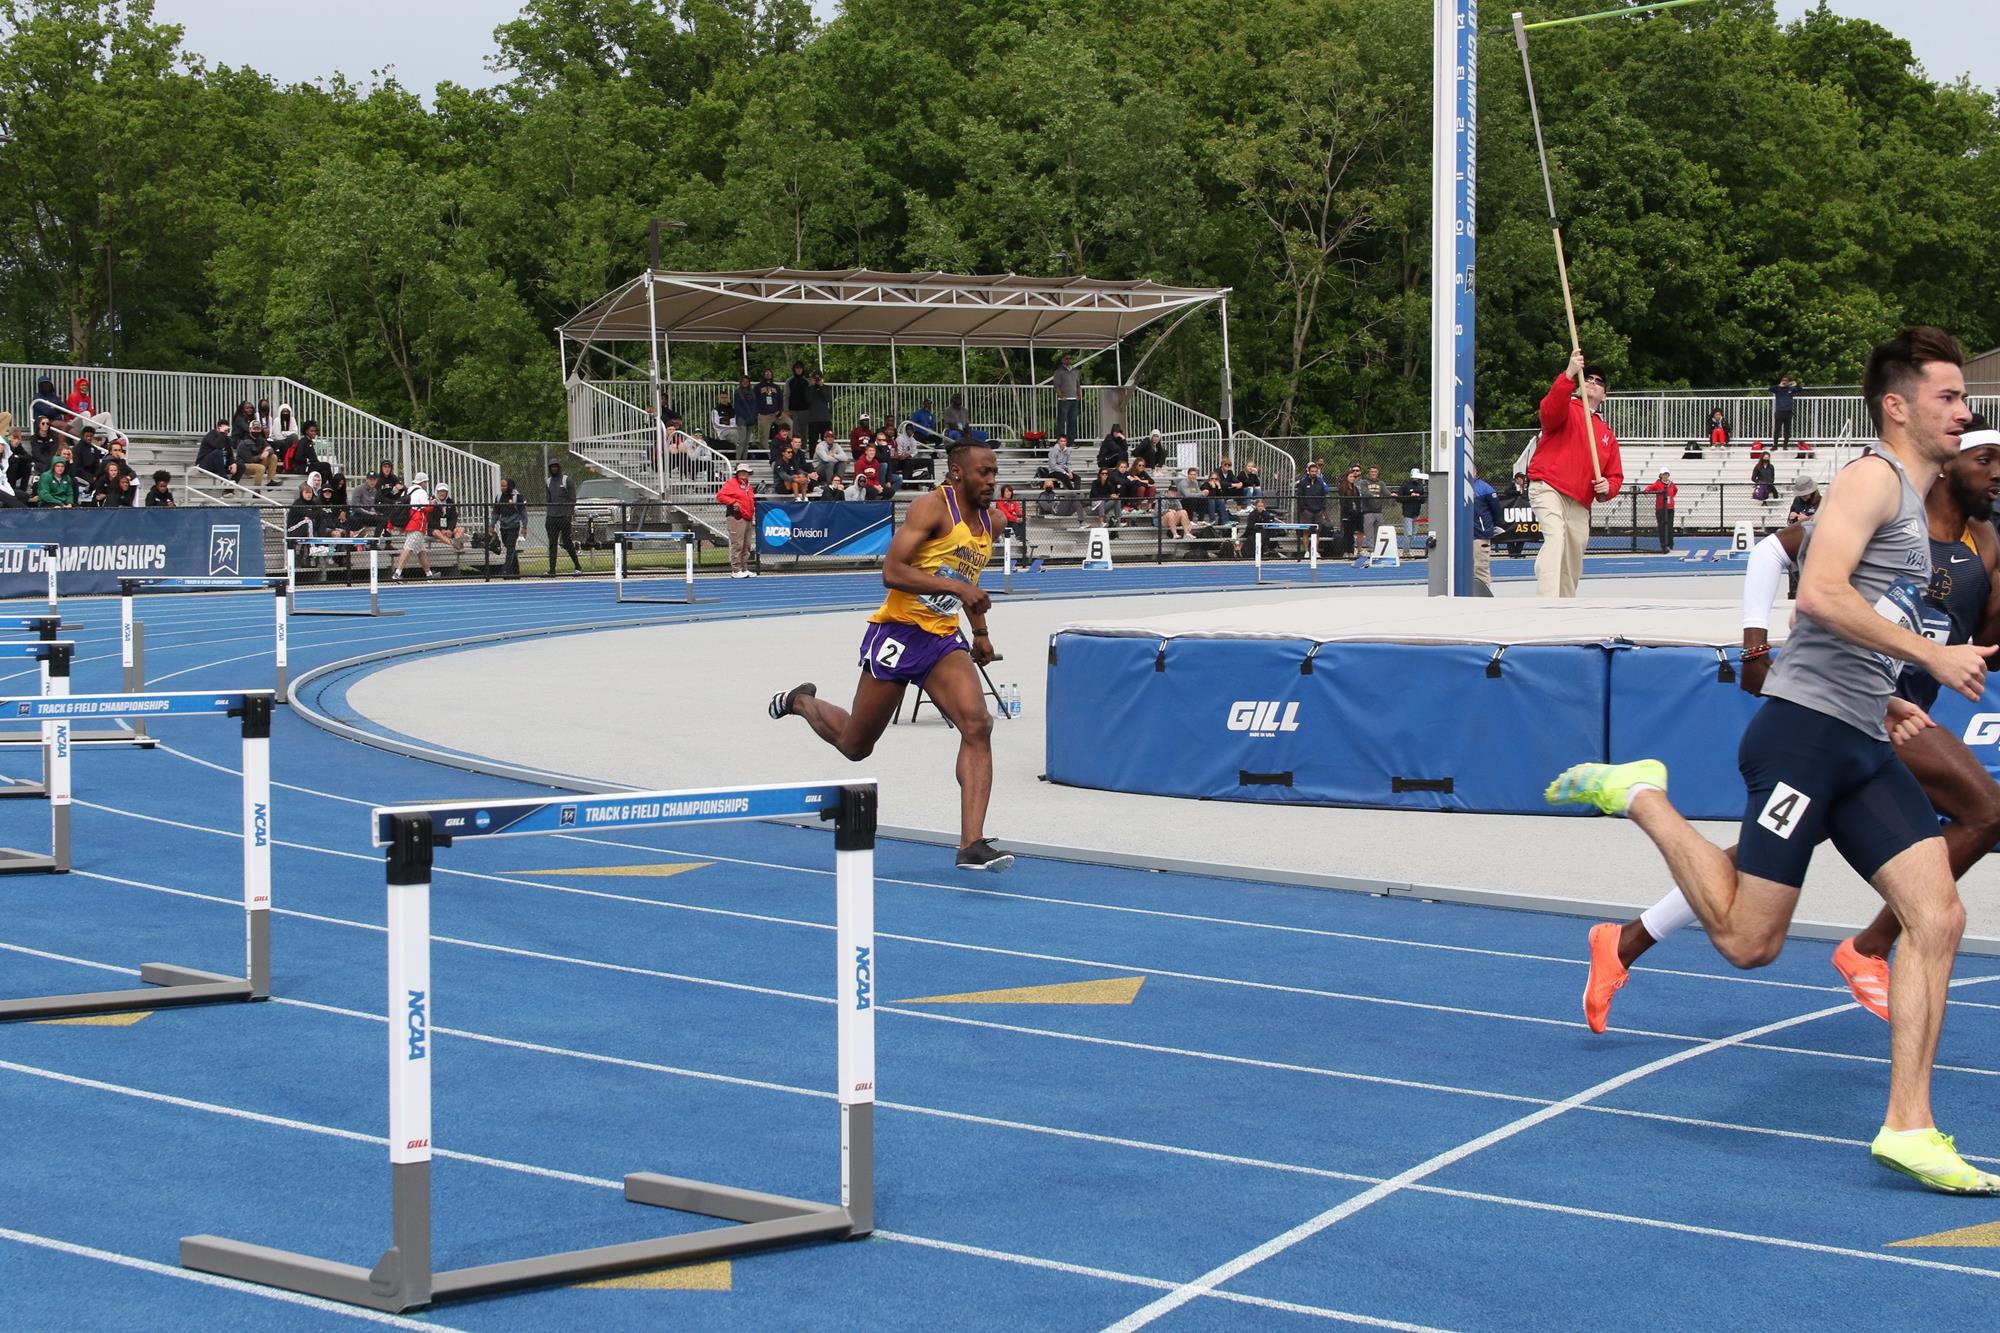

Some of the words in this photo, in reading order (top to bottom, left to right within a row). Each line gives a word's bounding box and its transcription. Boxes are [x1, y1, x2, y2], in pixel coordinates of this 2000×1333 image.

[1457, 13, 1465, 29] 14
[1457, 65, 1464, 80] 13
[1457, 117, 1464, 132] 12
[1467, 33, 1477, 240] CHAMPIONSHIPS
[1456, 172, 1464, 180] 11
[1456, 219, 1463, 236] 10
[1455, 324, 1463, 336] 8
[1463, 403, 1474, 504] GILL
[1504, 507, 1539, 523] UNI
[765, 526, 791, 537] NCAA
[793, 527, 822, 538] Division
[824, 528, 829, 538] II
[1515, 524, 1528, 533] AS
[1091, 541, 1103, 559] 8
[1379, 538, 1389, 556] 7
[1736, 533, 1747, 550] 6
[958, 561, 976, 581] STATE
[880, 644, 898, 665] 2
[38, 703, 66, 715] TRACK
[67, 703, 73, 714] &
[74, 702, 97, 714] FIELD
[99, 700, 170, 713] CHAMPIONSHIPS
[1227, 701, 1300, 731] GILL
[57, 726, 67, 758] NCAA
[805, 795, 823, 803] GILL
[585, 806, 619, 822] TRACK
[621, 806, 629, 820] &
[631, 804, 659, 819] FIELD
[662, 798, 749, 817] CHAMPIONSHIPS
[1767, 793, 1800, 831] 4
[254, 803, 268, 847] NCAA
[445, 817, 466, 826] GILL
[855, 946, 870, 1010] NCAA
[408, 990, 425, 1060] NCAA
[855, 1082, 873, 1091] GILL
[407, 1139, 429, 1149] GILL
